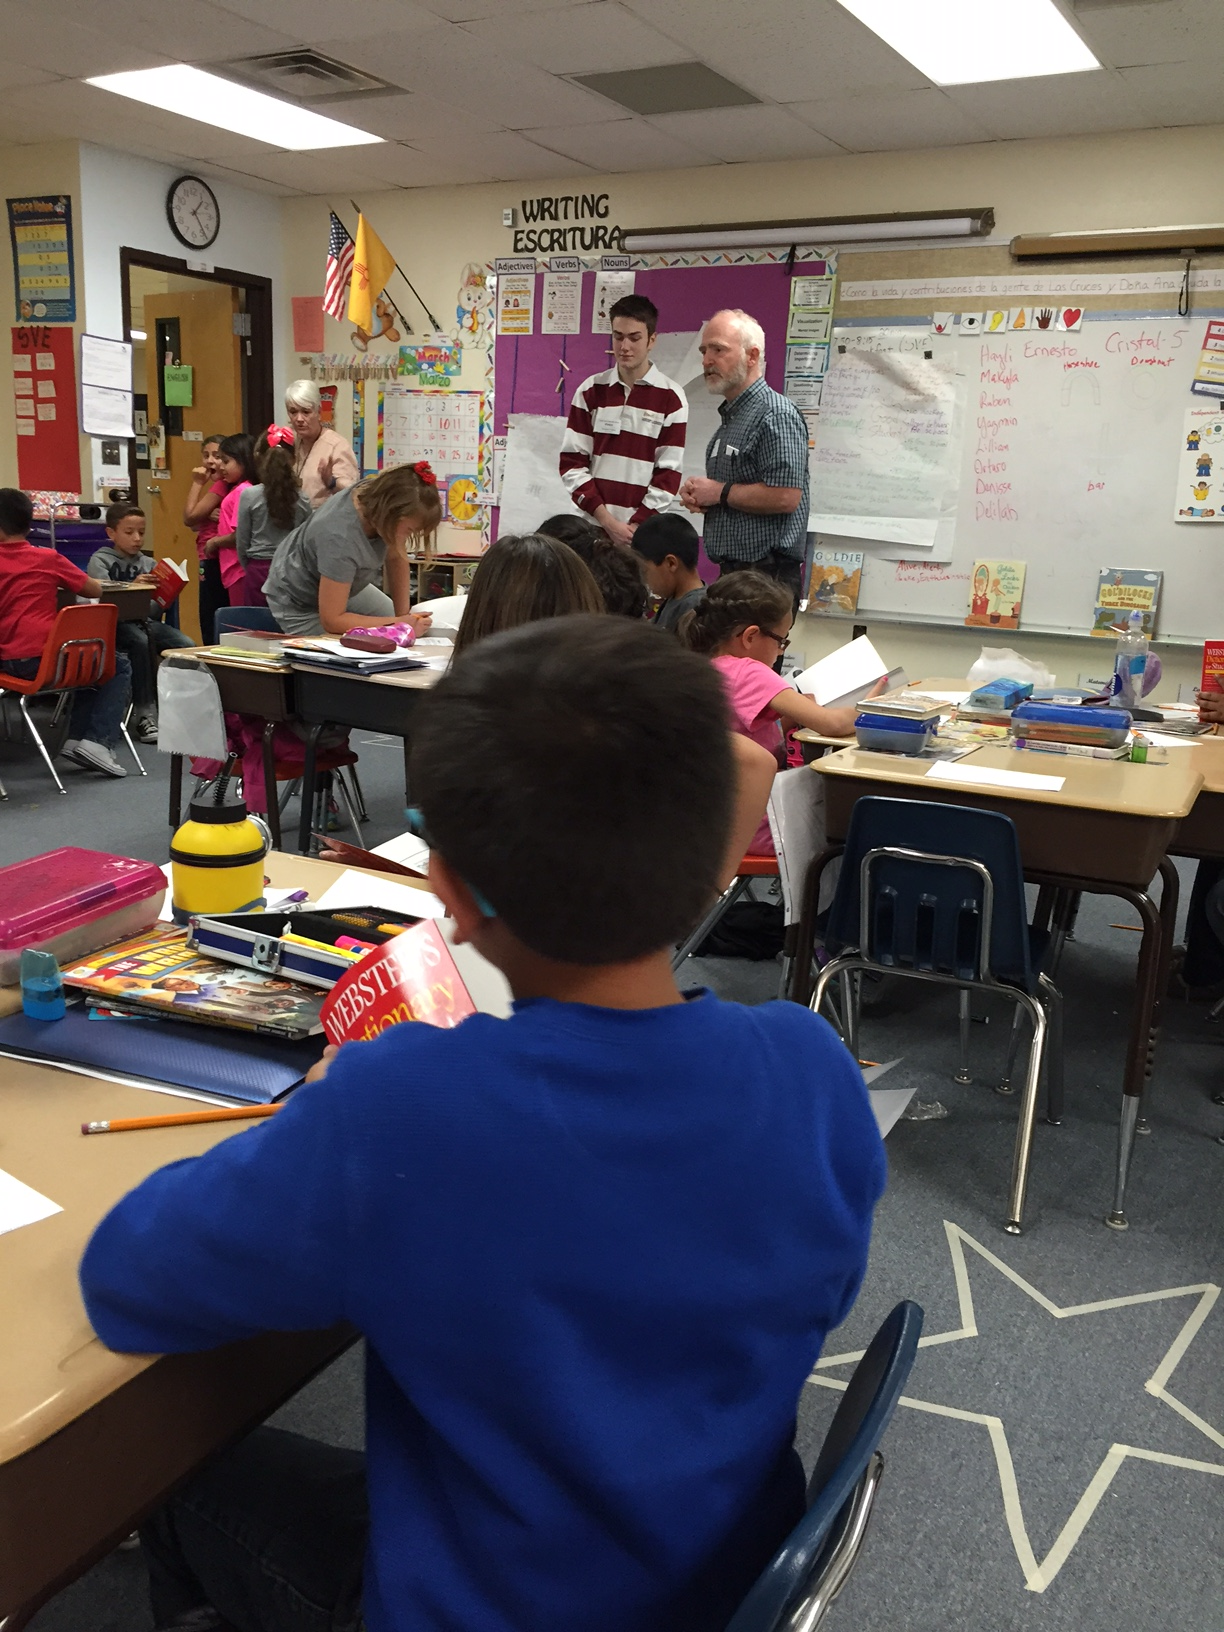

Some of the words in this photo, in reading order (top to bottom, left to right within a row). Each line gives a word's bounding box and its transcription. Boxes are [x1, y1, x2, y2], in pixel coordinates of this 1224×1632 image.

[522, 194, 609, 223] WRITING
[513, 225, 622, 253] ESCRITURA
[497, 262, 534, 272] Adjectives
[555, 260, 577, 269] Verbs
[603, 258, 628, 267] Nouns
[975, 285, 986, 294] de
[1002, 283, 1030, 296] gente
[1049, 281, 1067, 292] Las
[1070, 279, 1102, 291] Cruces
[1154, 276, 1175, 289] Ana
[17, 325, 51, 349] SVE
[1023, 340, 1078, 359] Ernesto
[419, 372, 451, 387] Marzo
[439, 417, 451, 430] 10
[815, 551, 861, 562] GOLDIE
[1101, 587, 1154, 600] GOLDILOCKS
